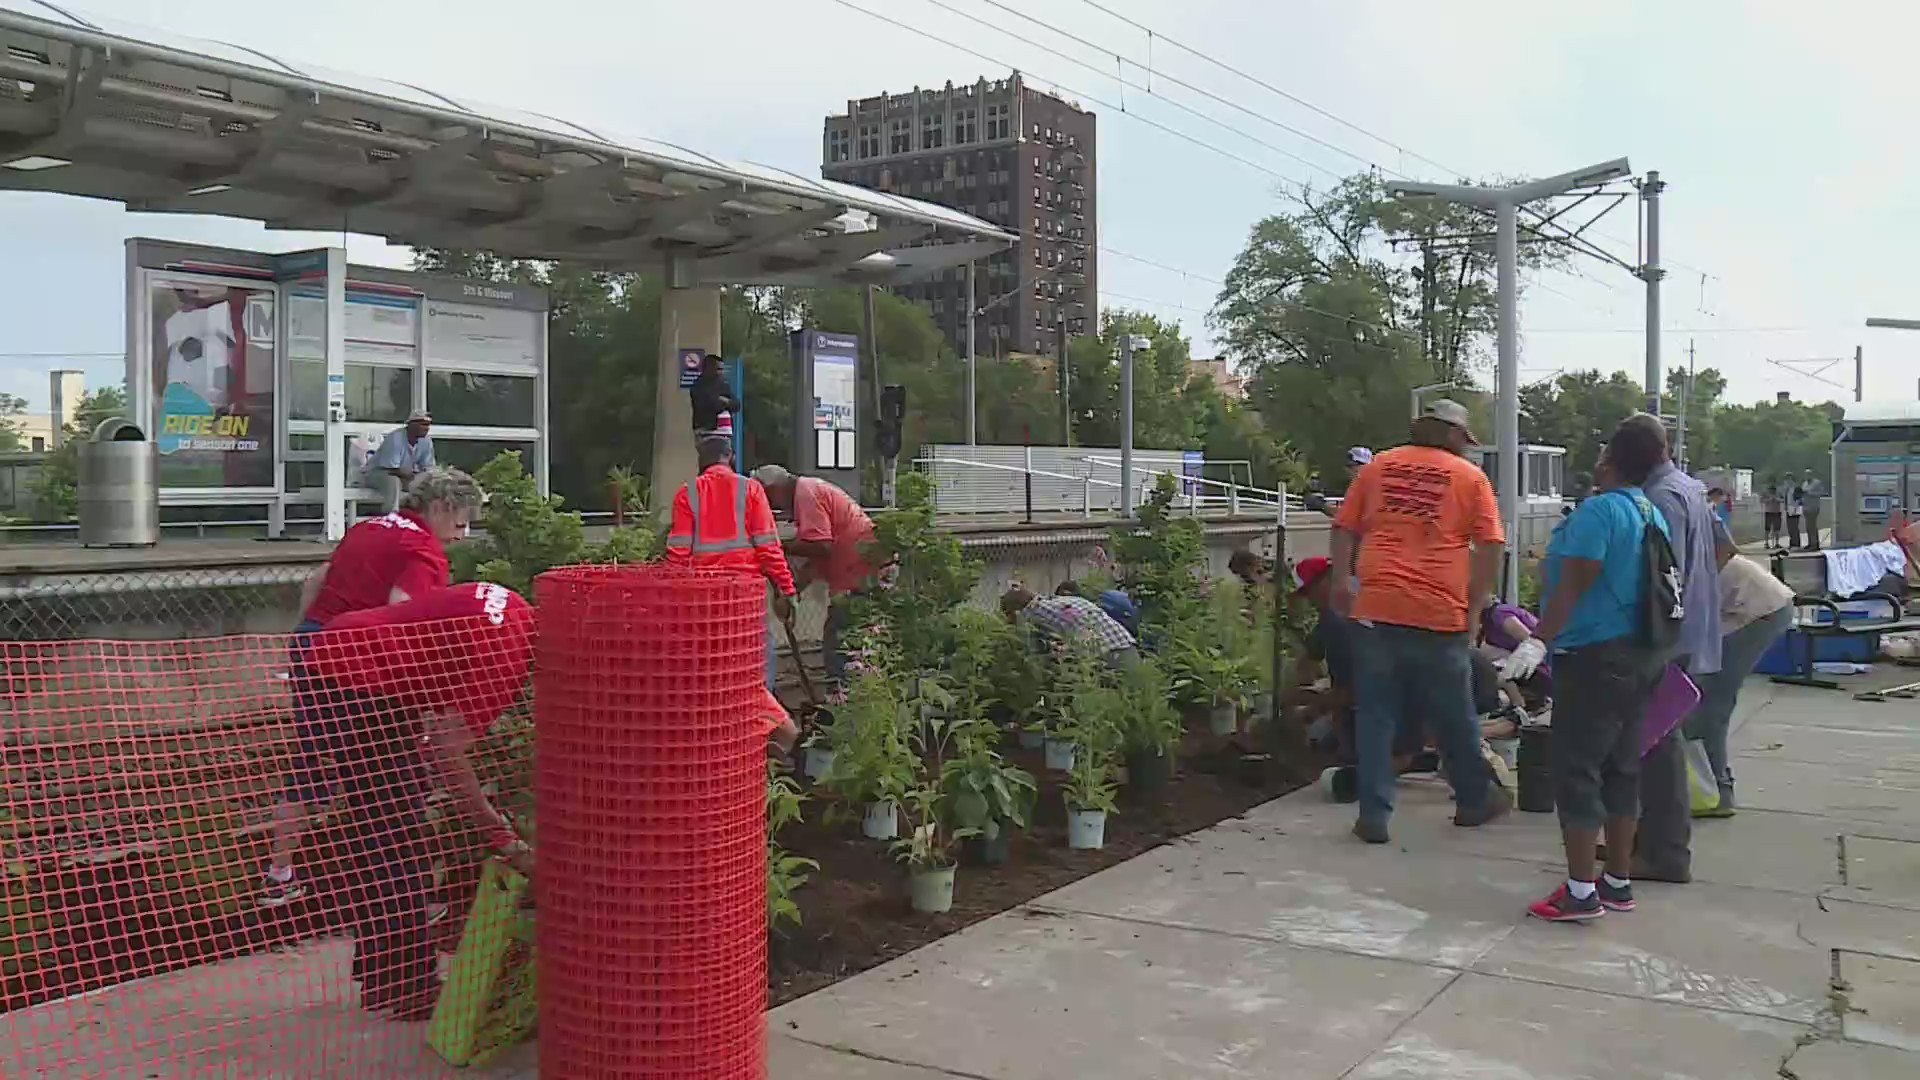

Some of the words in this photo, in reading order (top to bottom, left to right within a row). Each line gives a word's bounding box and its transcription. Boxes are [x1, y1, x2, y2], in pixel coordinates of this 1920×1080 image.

[163, 415, 214, 434] RIDE
[218, 415, 250, 437] ON
[178, 438, 191, 449] to
[192, 439, 235, 450] season
[237, 440, 259, 451] one
